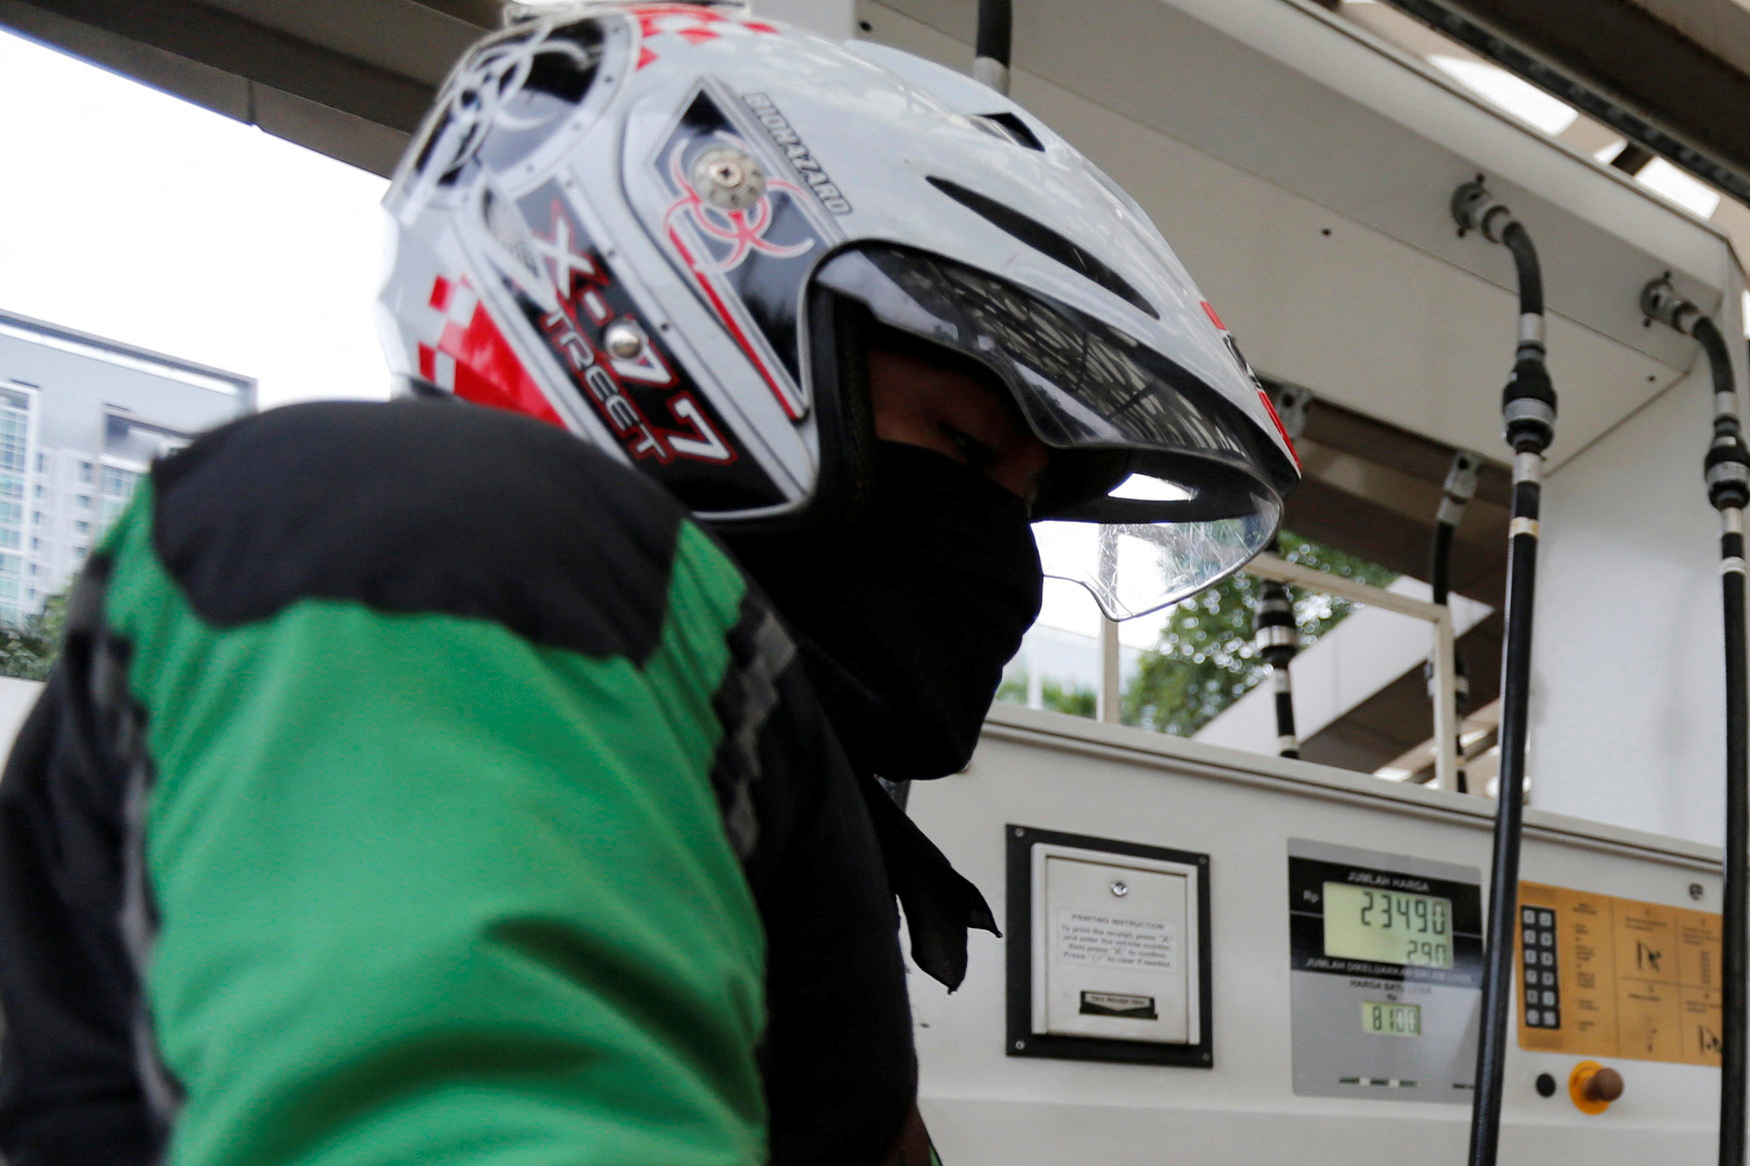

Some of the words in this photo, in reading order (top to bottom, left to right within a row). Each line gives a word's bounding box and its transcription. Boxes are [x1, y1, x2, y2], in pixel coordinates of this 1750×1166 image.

[742, 92, 853, 215] BIOHAZARD
[543, 306, 670, 460] TREET
[1347, 872, 1390, 886] JUMLAH
[1391, 878, 1430, 892] HARGA
[1361, 891, 1446, 935] 23490
[1372, 1005, 1418, 1033] 8100
